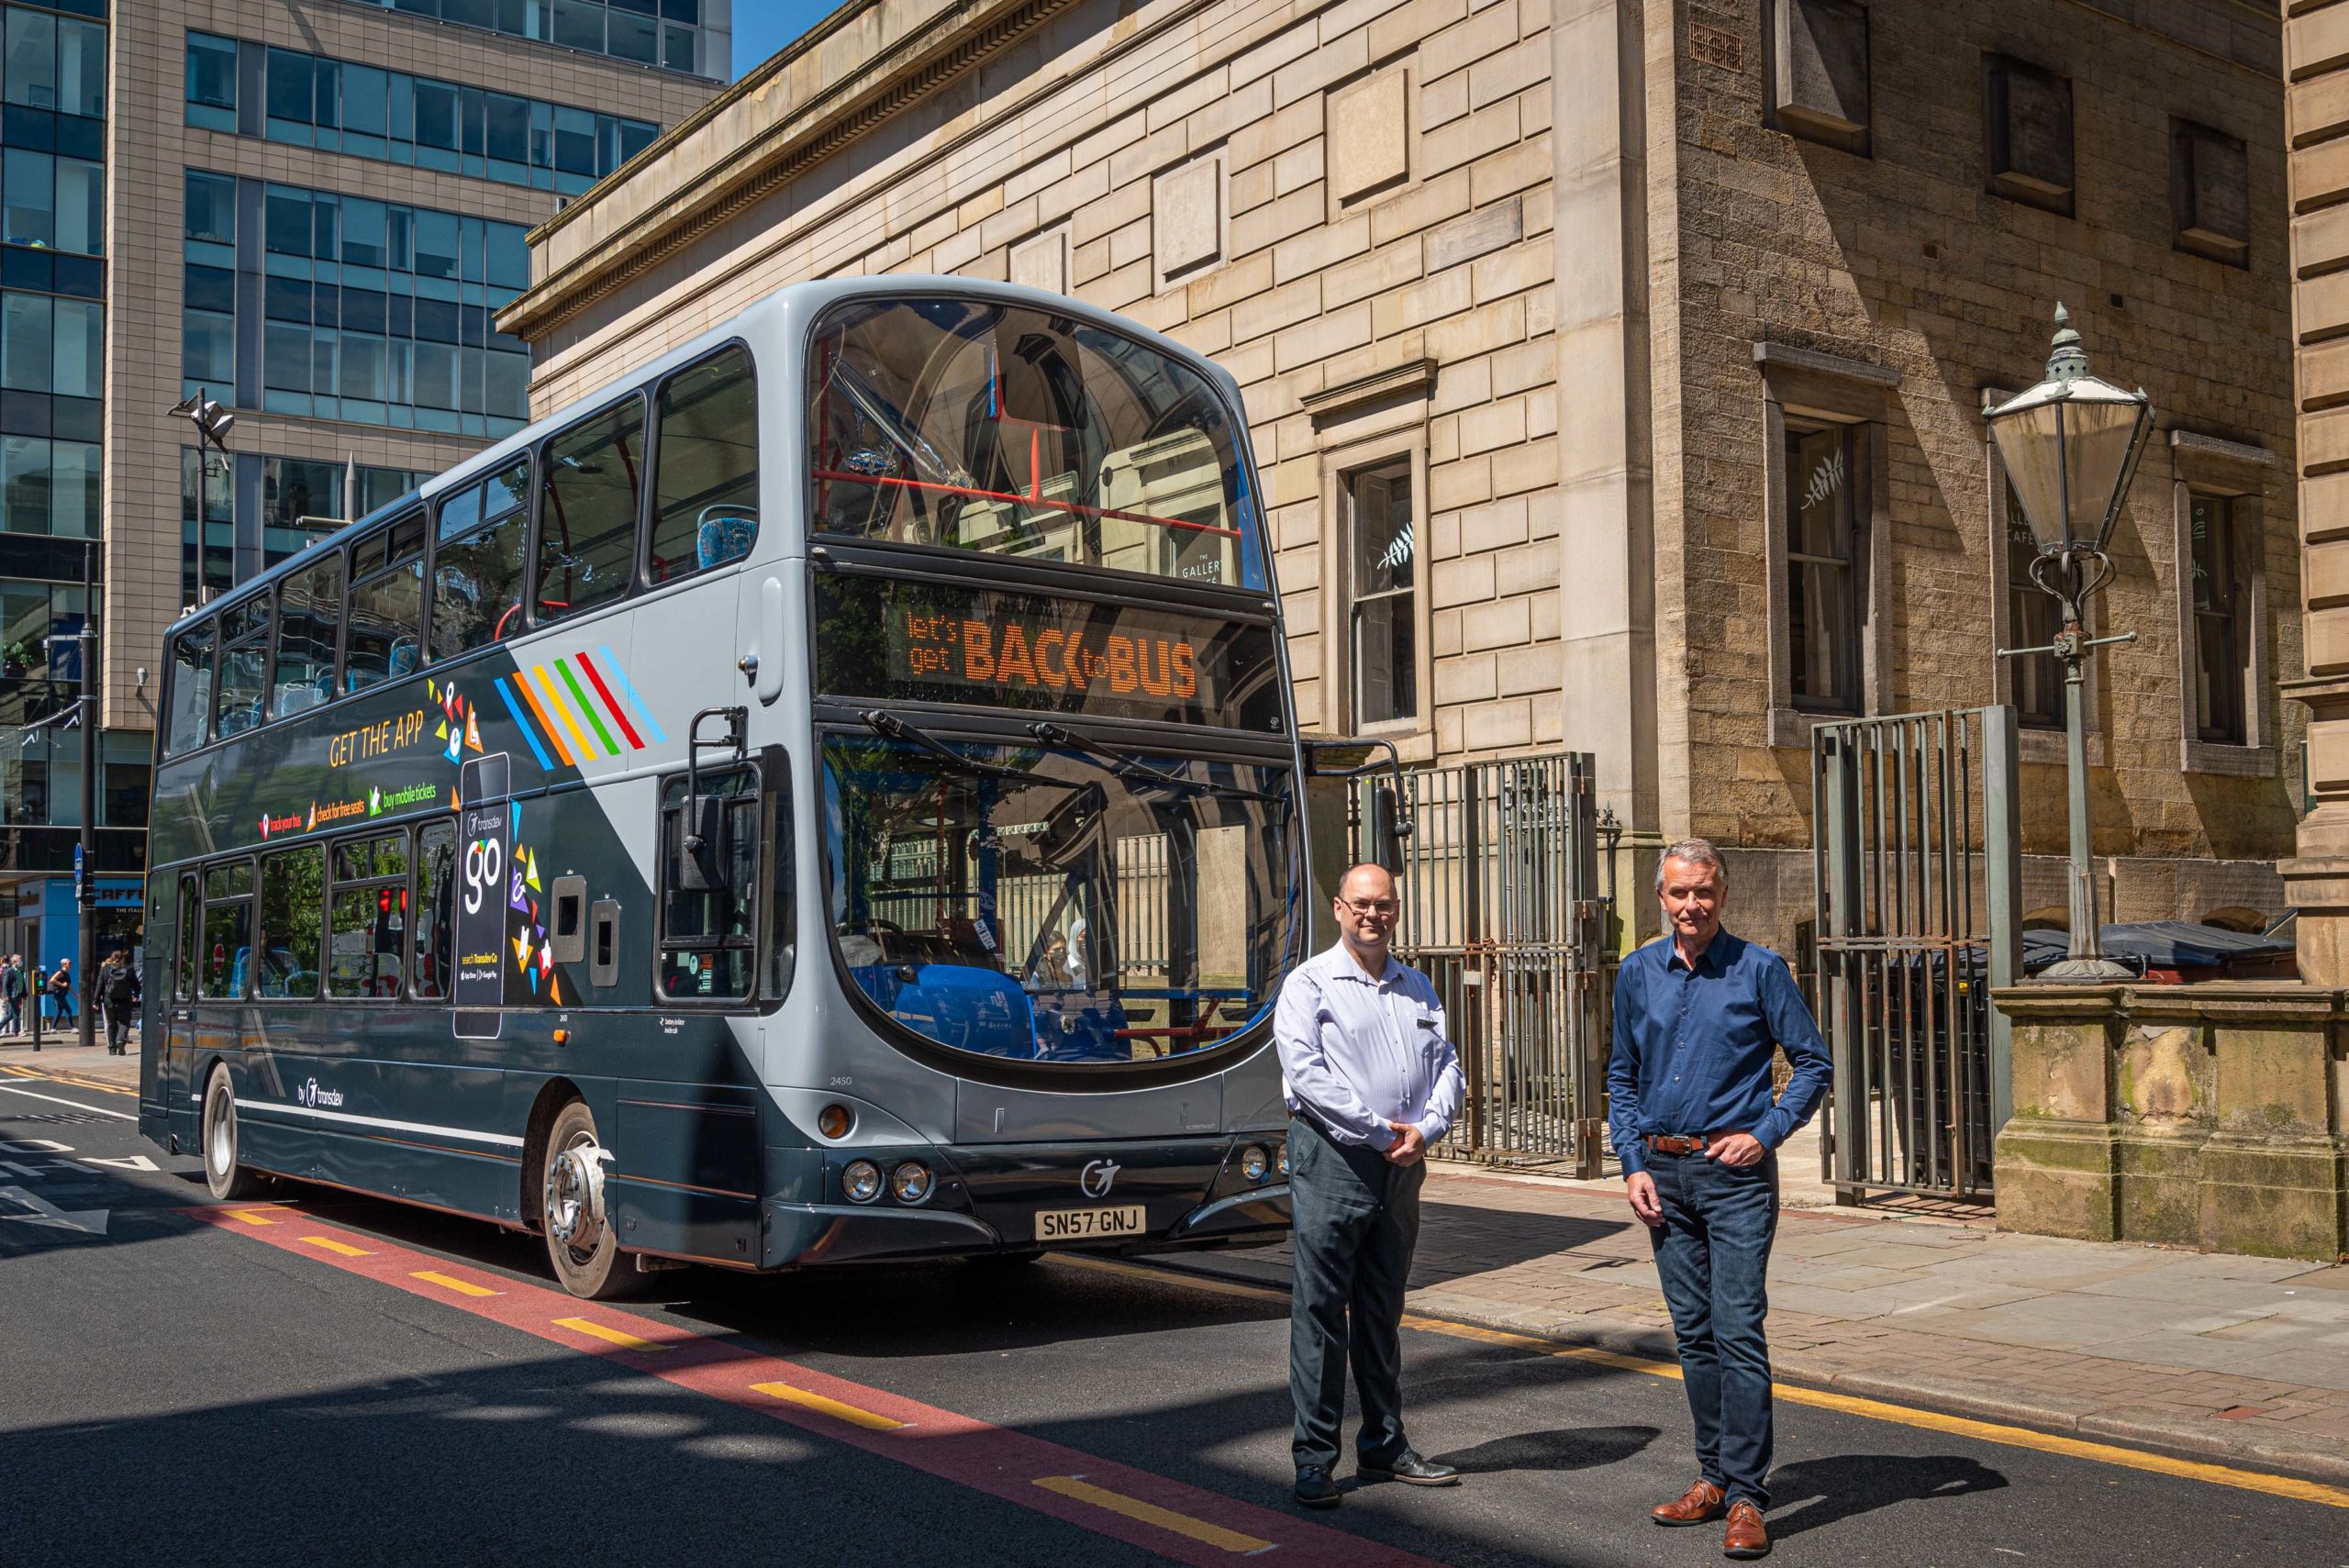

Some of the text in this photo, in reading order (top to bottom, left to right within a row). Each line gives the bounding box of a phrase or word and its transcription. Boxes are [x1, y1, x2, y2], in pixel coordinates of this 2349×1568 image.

[1182, 560, 1222, 578] GALLER
[907, 611, 957, 643] let's
[909, 646, 950, 675] get
[963, 619, 1197, 698] BACK to BUS
[329, 708, 425, 768] GET THE APP
[383, 781, 437, 810] buy mobile tickets
[270, 811, 302, 834] track your bus
[317, 798, 365, 823] check for free seats
[477, 815, 503, 831] transdev
[464, 838, 501, 915] go
[829, 1076, 852, 1085] 2450
[297, 1084, 344, 1106] by transdev
[1042, 1208, 1138, 1236] SN57 GNJ
